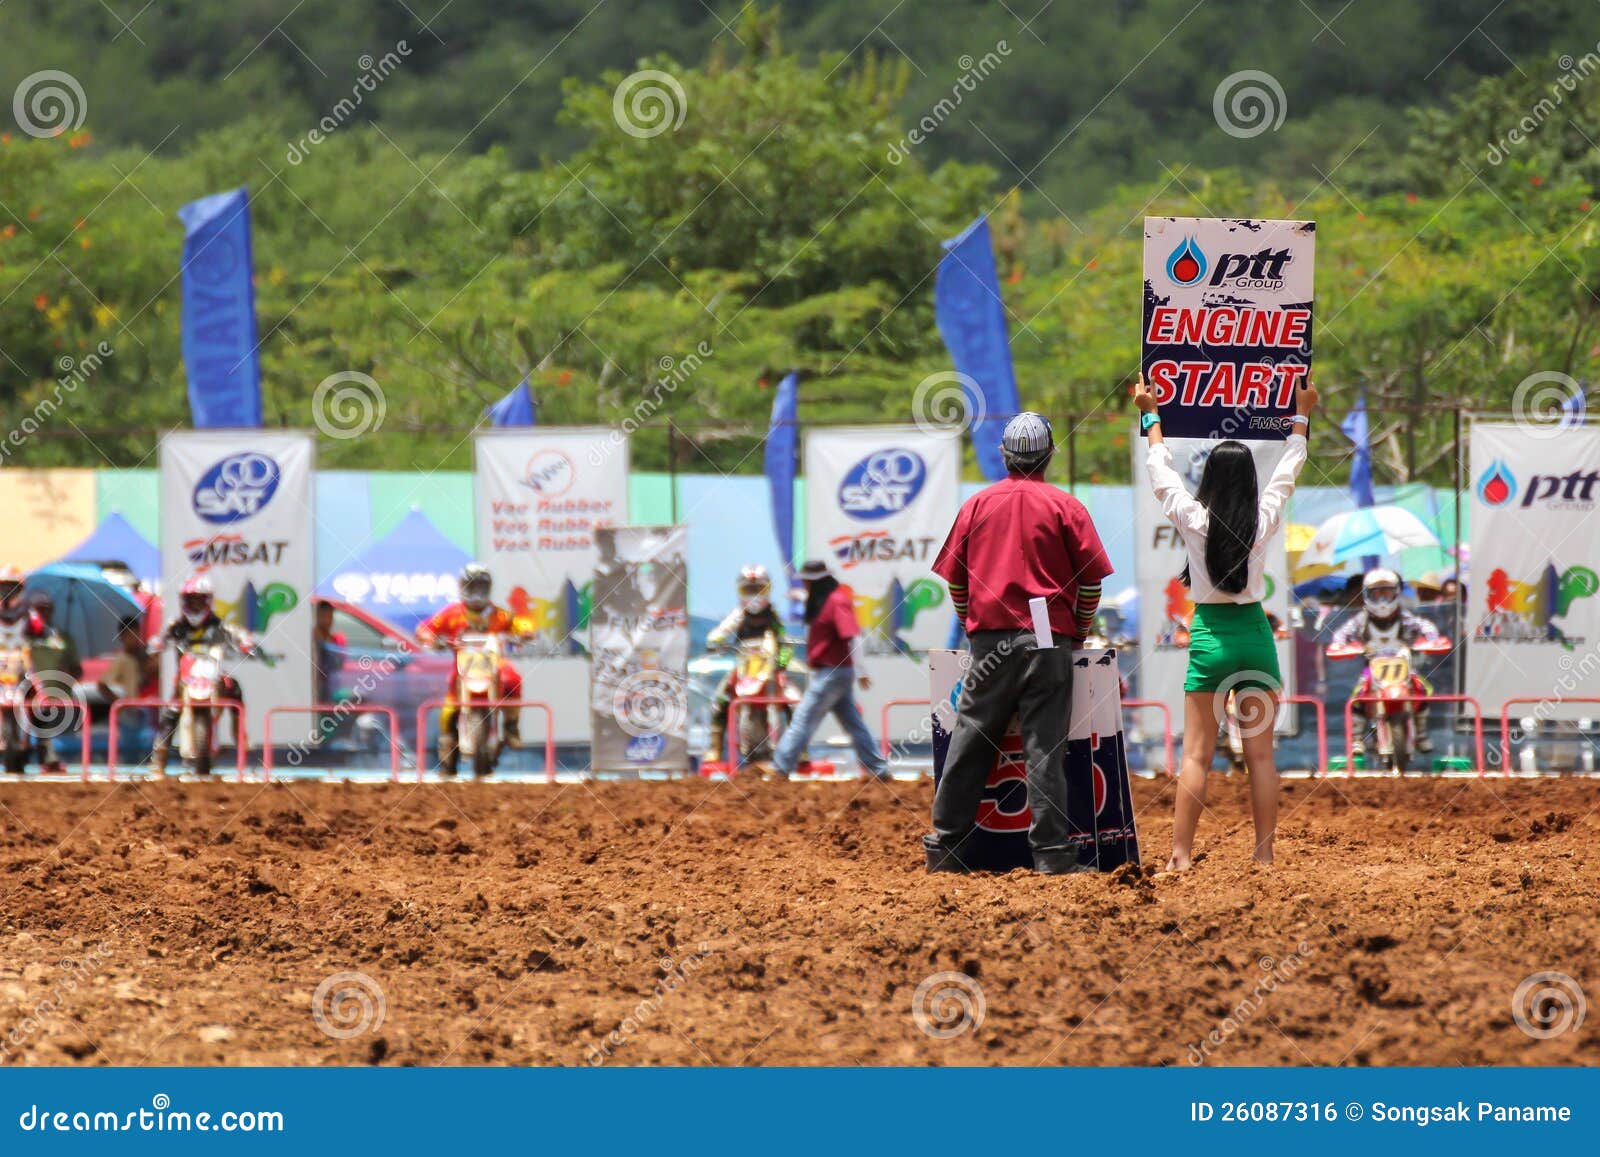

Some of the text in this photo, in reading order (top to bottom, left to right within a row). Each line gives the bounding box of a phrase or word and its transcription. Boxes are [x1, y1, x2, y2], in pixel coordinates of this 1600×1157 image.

[1209, 247, 1292, 287] ptt
[1235, 276, 1285, 290] Group
[1147, 306, 1310, 347] ENGINE
[1148, 360, 1307, 408] START
[1248, 416, 1297, 430] FMSC
[538, 536, 591, 551] Rubb
